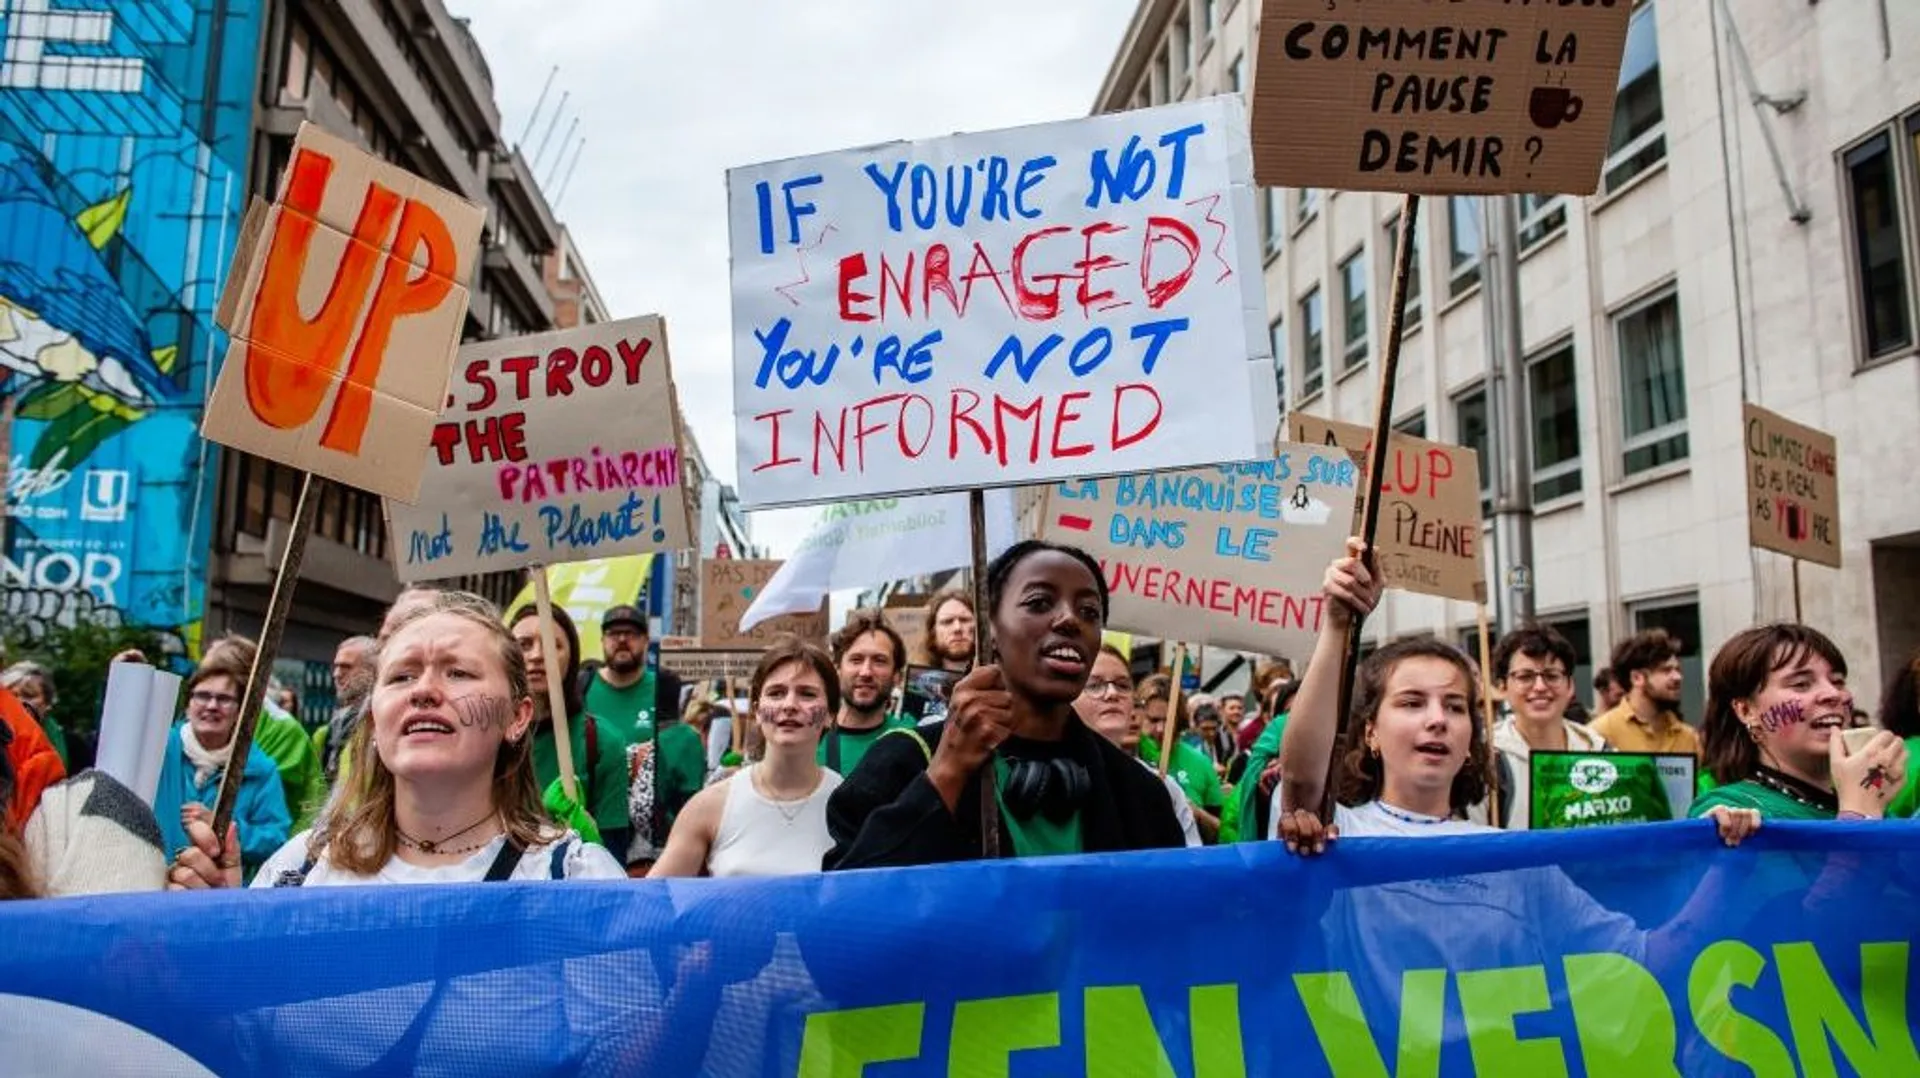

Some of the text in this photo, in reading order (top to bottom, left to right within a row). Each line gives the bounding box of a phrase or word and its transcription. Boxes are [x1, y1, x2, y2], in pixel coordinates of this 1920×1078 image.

[1284, 22, 1577, 65] COMMENT LA
[1371, 72, 1494, 114] PAUSE
[1359, 129, 1504, 177] DEMIR
[755, 123, 1205, 254] IF YOU'RE NOT
[837, 217, 1200, 322] ENRAGED
[245, 148, 457, 457] UP
[447, 338, 652, 411] STROY
[754, 318, 1189, 389] YOU'RE NOT
[430, 412, 528, 465] THE
[753, 384, 1162, 475] INFORMED
[1748, 417, 1804, 467] CLIMATE
[1300, 455, 1354, 488] SUR
[1755, 464, 1766, 489] IS
[1787, 470, 1818, 499] REAL
[478, 511, 529, 558] the
[1110, 513, 1188, 549] DANS
[1216, 527, 1279, 562] LE
[1755, 498, 1771, 521] AS
[1774, 496, 1808, 541] YOU
[1396, 553, 1441, 586] JUSTICE
[1101, 559, 1327, 633] UVERNEMENT
